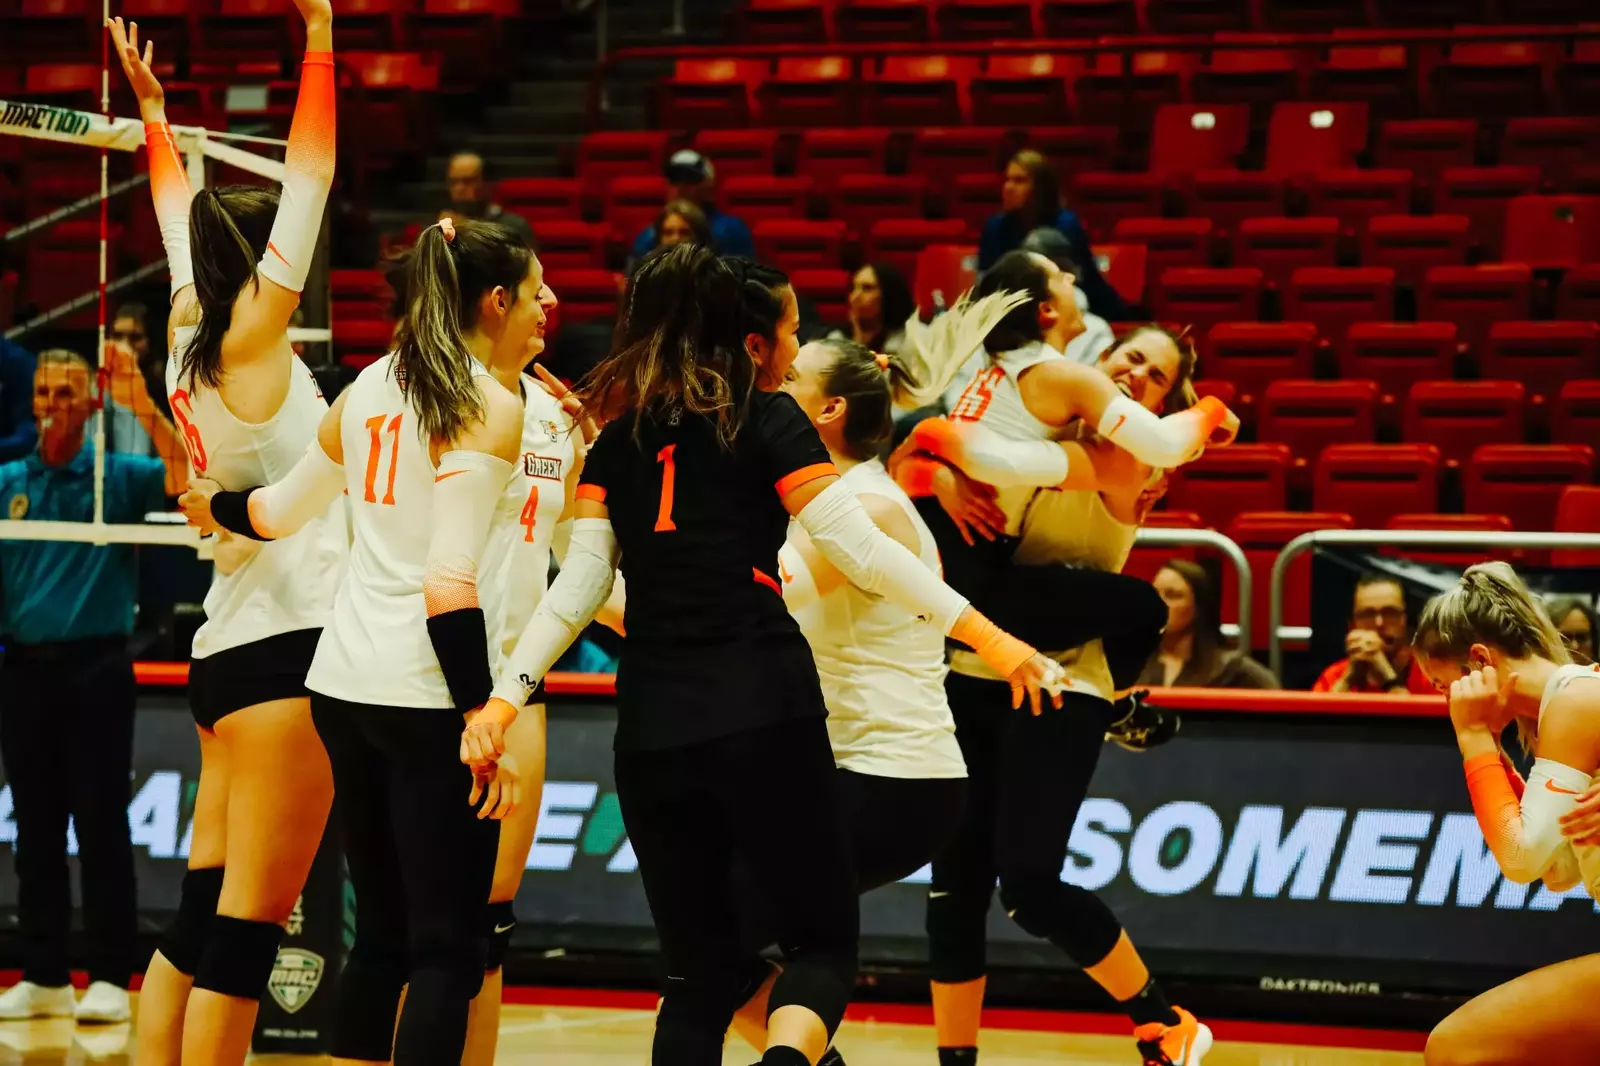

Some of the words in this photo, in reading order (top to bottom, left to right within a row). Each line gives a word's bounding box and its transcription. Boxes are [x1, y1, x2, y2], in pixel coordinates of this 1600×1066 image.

[364, 413, 403, 505] 11
[654, 443, 676, 532] 1
[519, 485, 538, 543] 4
